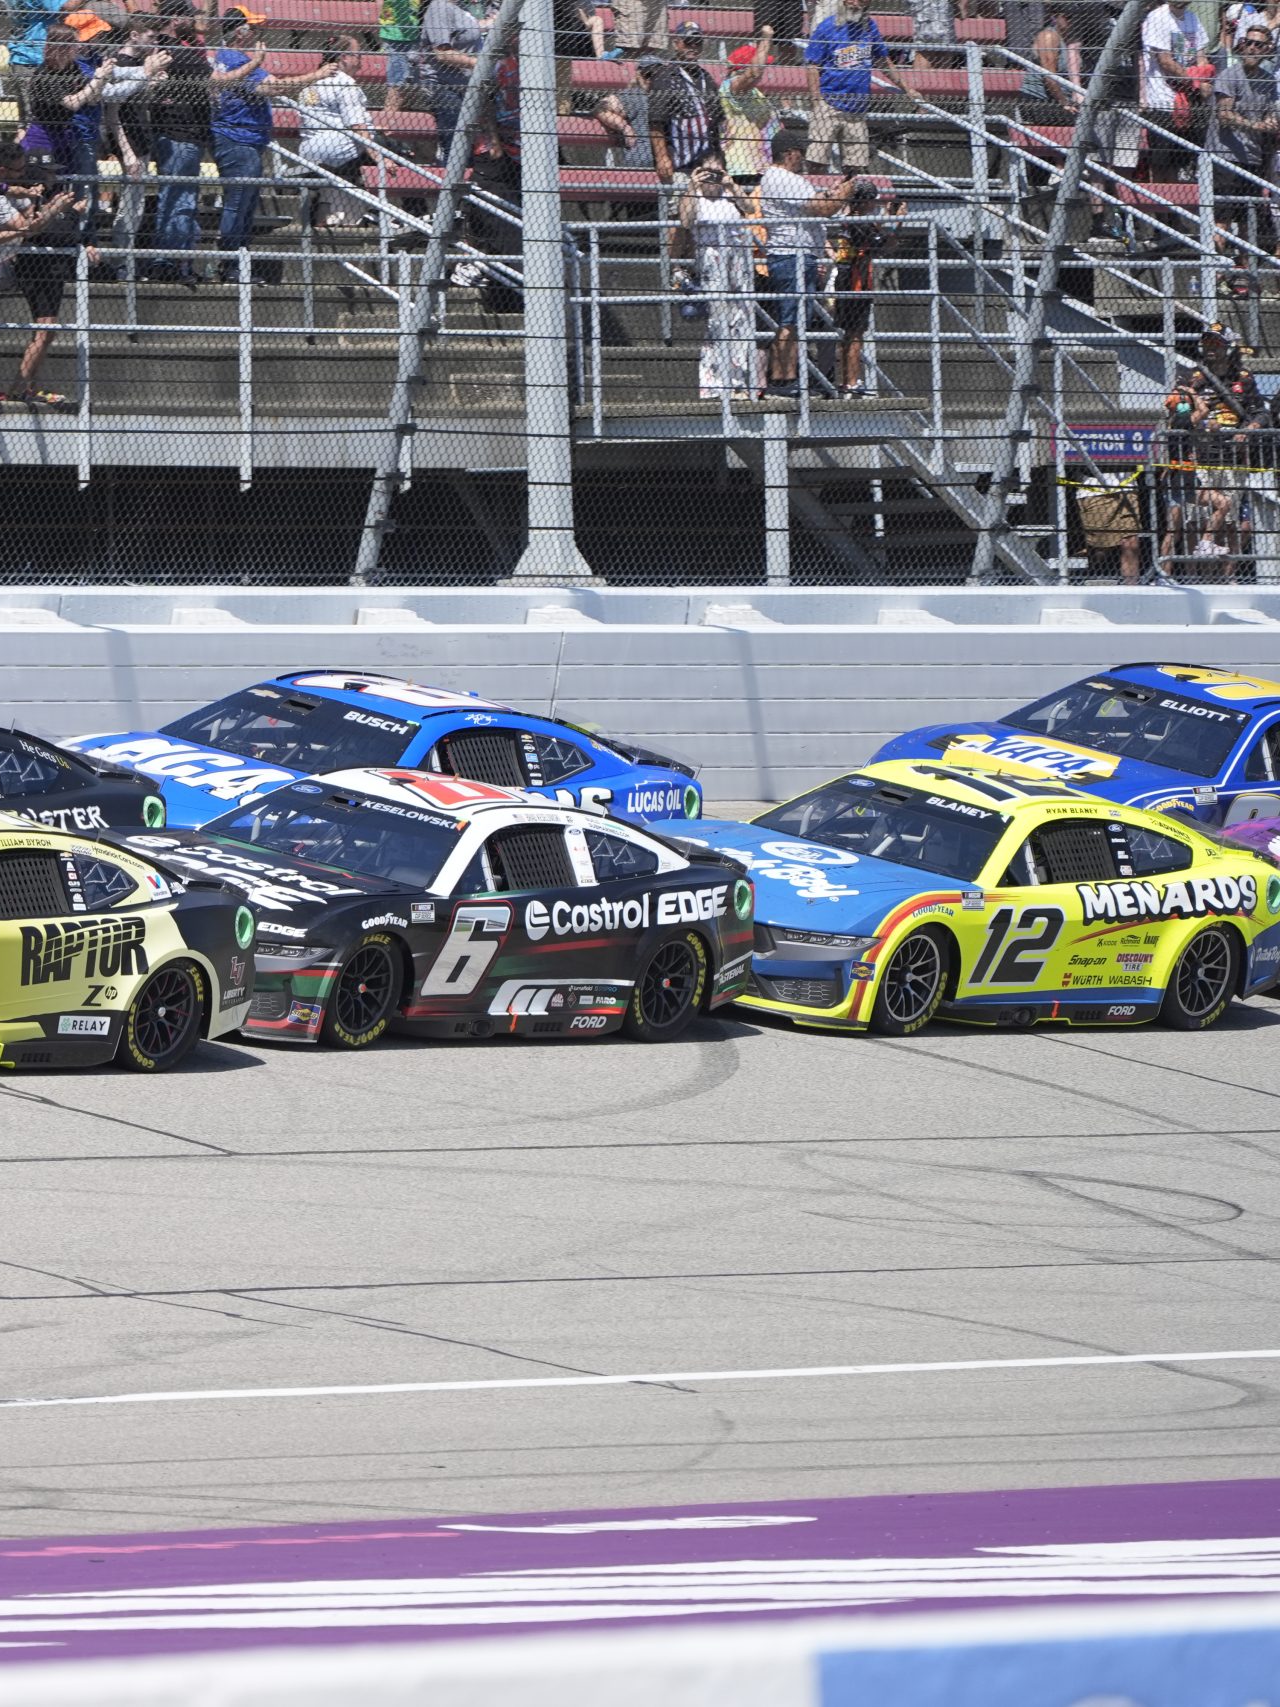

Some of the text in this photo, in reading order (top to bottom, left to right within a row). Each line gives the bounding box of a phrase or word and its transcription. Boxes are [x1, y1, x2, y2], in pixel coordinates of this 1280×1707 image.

[1160, 698, 1232, 723] ELLIOTT
[343, 710, 409, 736] BUSCH
[19, 740, 34, 754] He
[34, 747, 57, 764] Gets
[986, 737, 1091, 772] NAPA
[627, 793, 664, 813] LUCAS
[666, 788, 681, 811] OIL
[925, 796, 993, 819] BLANEY
[361, 800, 458, 829] KESELOWSKI
[27, 839, 52, 847] BYRON
[552, 885, 728, 936] Castrol EDGE
[912, 904, 954, 918] GOODYEAR
[1082, 875, 1257, 925] MENARDS
[257, 921, 309, 938] EDGE
[362, 913, 409, 931] GOODYEAR
[20, 917, 149, 986] RAPTOR
[363, 935, 391, 946] EAGLE
[420, 906, 510, 996] 6
[968, 905, 1066, 986] 12
[686, 932, 706, 1006] GOODYEAR
[1068, 955, 1107, 967] Snap-on
[1116, 953, 1154, 963] DISCOUNT
[189, 966, 204, 1002] EAGLE
[1072, 975, 1153, 986] WÜRTH WABASH
[81, 985, 105, 1006] Z
[223, 987, 245, 1000] LIBERTY
[595, 996, 617, 1005] FARO
[570, 1016, 607, 1029] FORD
[1107, 1006, 1136, 1016] FORD
[71, 1019, 106, 1032] RELAY
[334, 1018, 387, 1046] GOODYEAR
